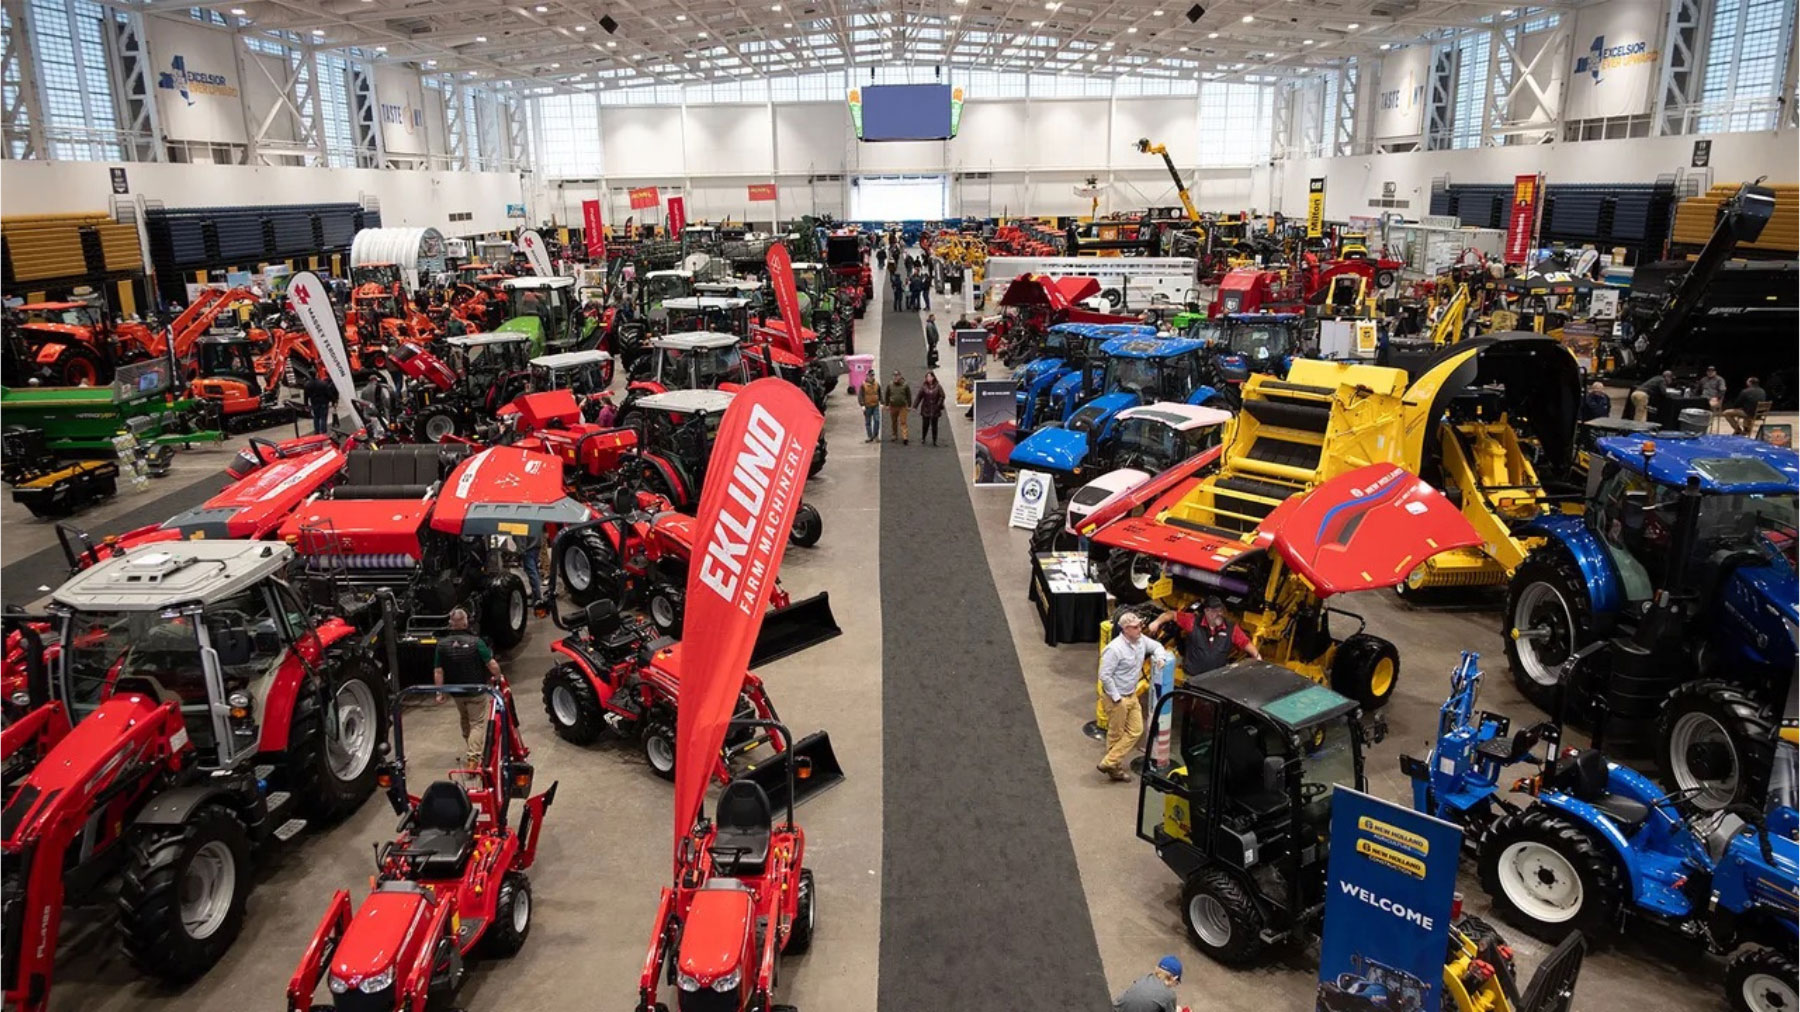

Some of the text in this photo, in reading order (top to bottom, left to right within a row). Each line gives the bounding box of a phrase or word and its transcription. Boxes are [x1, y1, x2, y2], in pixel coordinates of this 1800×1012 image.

[1603, 42, 1646, 59] EXCELSIOR
[187, 71, 226, 86] EXCELSIOR
[1381, 90, 1400, 110] TASTE
[381, 104, 402, 124] TASTE
[1311, 199, 1320, 231] Milton
[1544, 271, 1573, 283] CAT
[307, 307, 346, 378] MASSEY FERGUSON
[1378, 467, 1404, 486] HOLLAND
[700, 402, 785, 604] EKLUND
[740, 438, 802, 616] FARM MACHINERY
[1374, 825, 1424, 847] NEW HOLLAND
[1372, 848, 1421, 871] NEW HOLLAND
[1340, 880, 1434, 931] WELCOME
